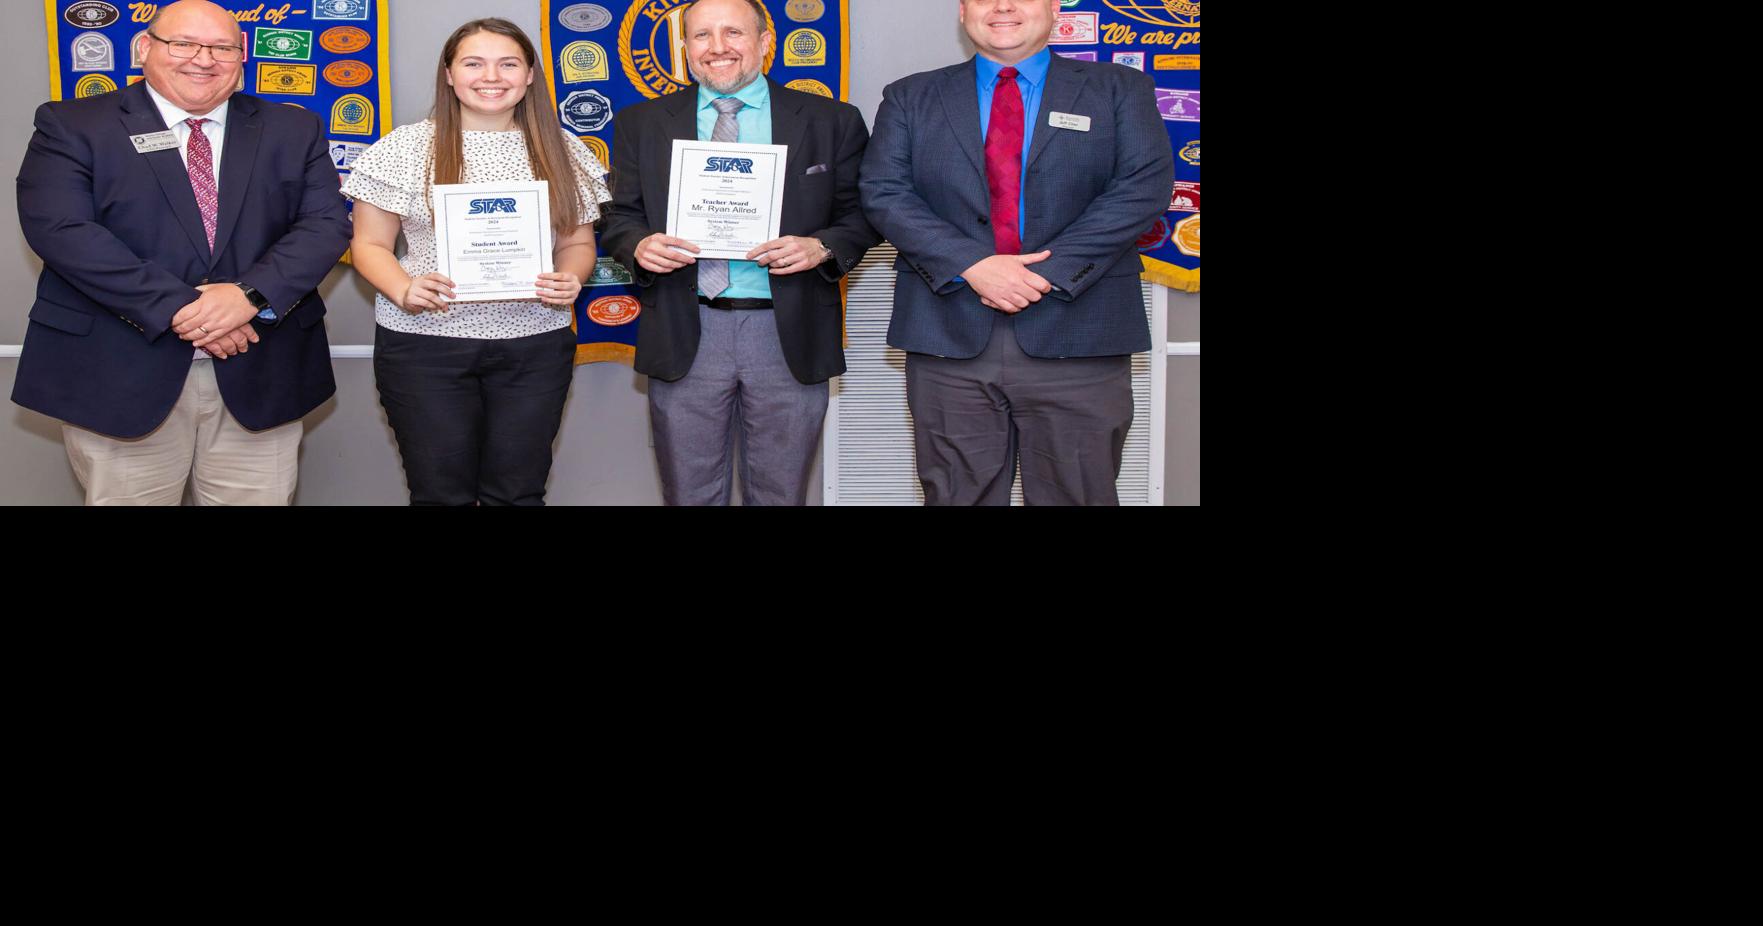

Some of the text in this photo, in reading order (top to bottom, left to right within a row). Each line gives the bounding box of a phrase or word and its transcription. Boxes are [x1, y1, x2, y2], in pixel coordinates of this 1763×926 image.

[264, 3, 291, 25] of
[1100, 22, 1138, 45] We
[1141, 30, 1175, 45] are
[704, 156, 754, 174] STAR
[468, 197, 517, 215] STAR
[708, 205, 730, 214] Ryan
[732, 206, 757, 214] Allred
